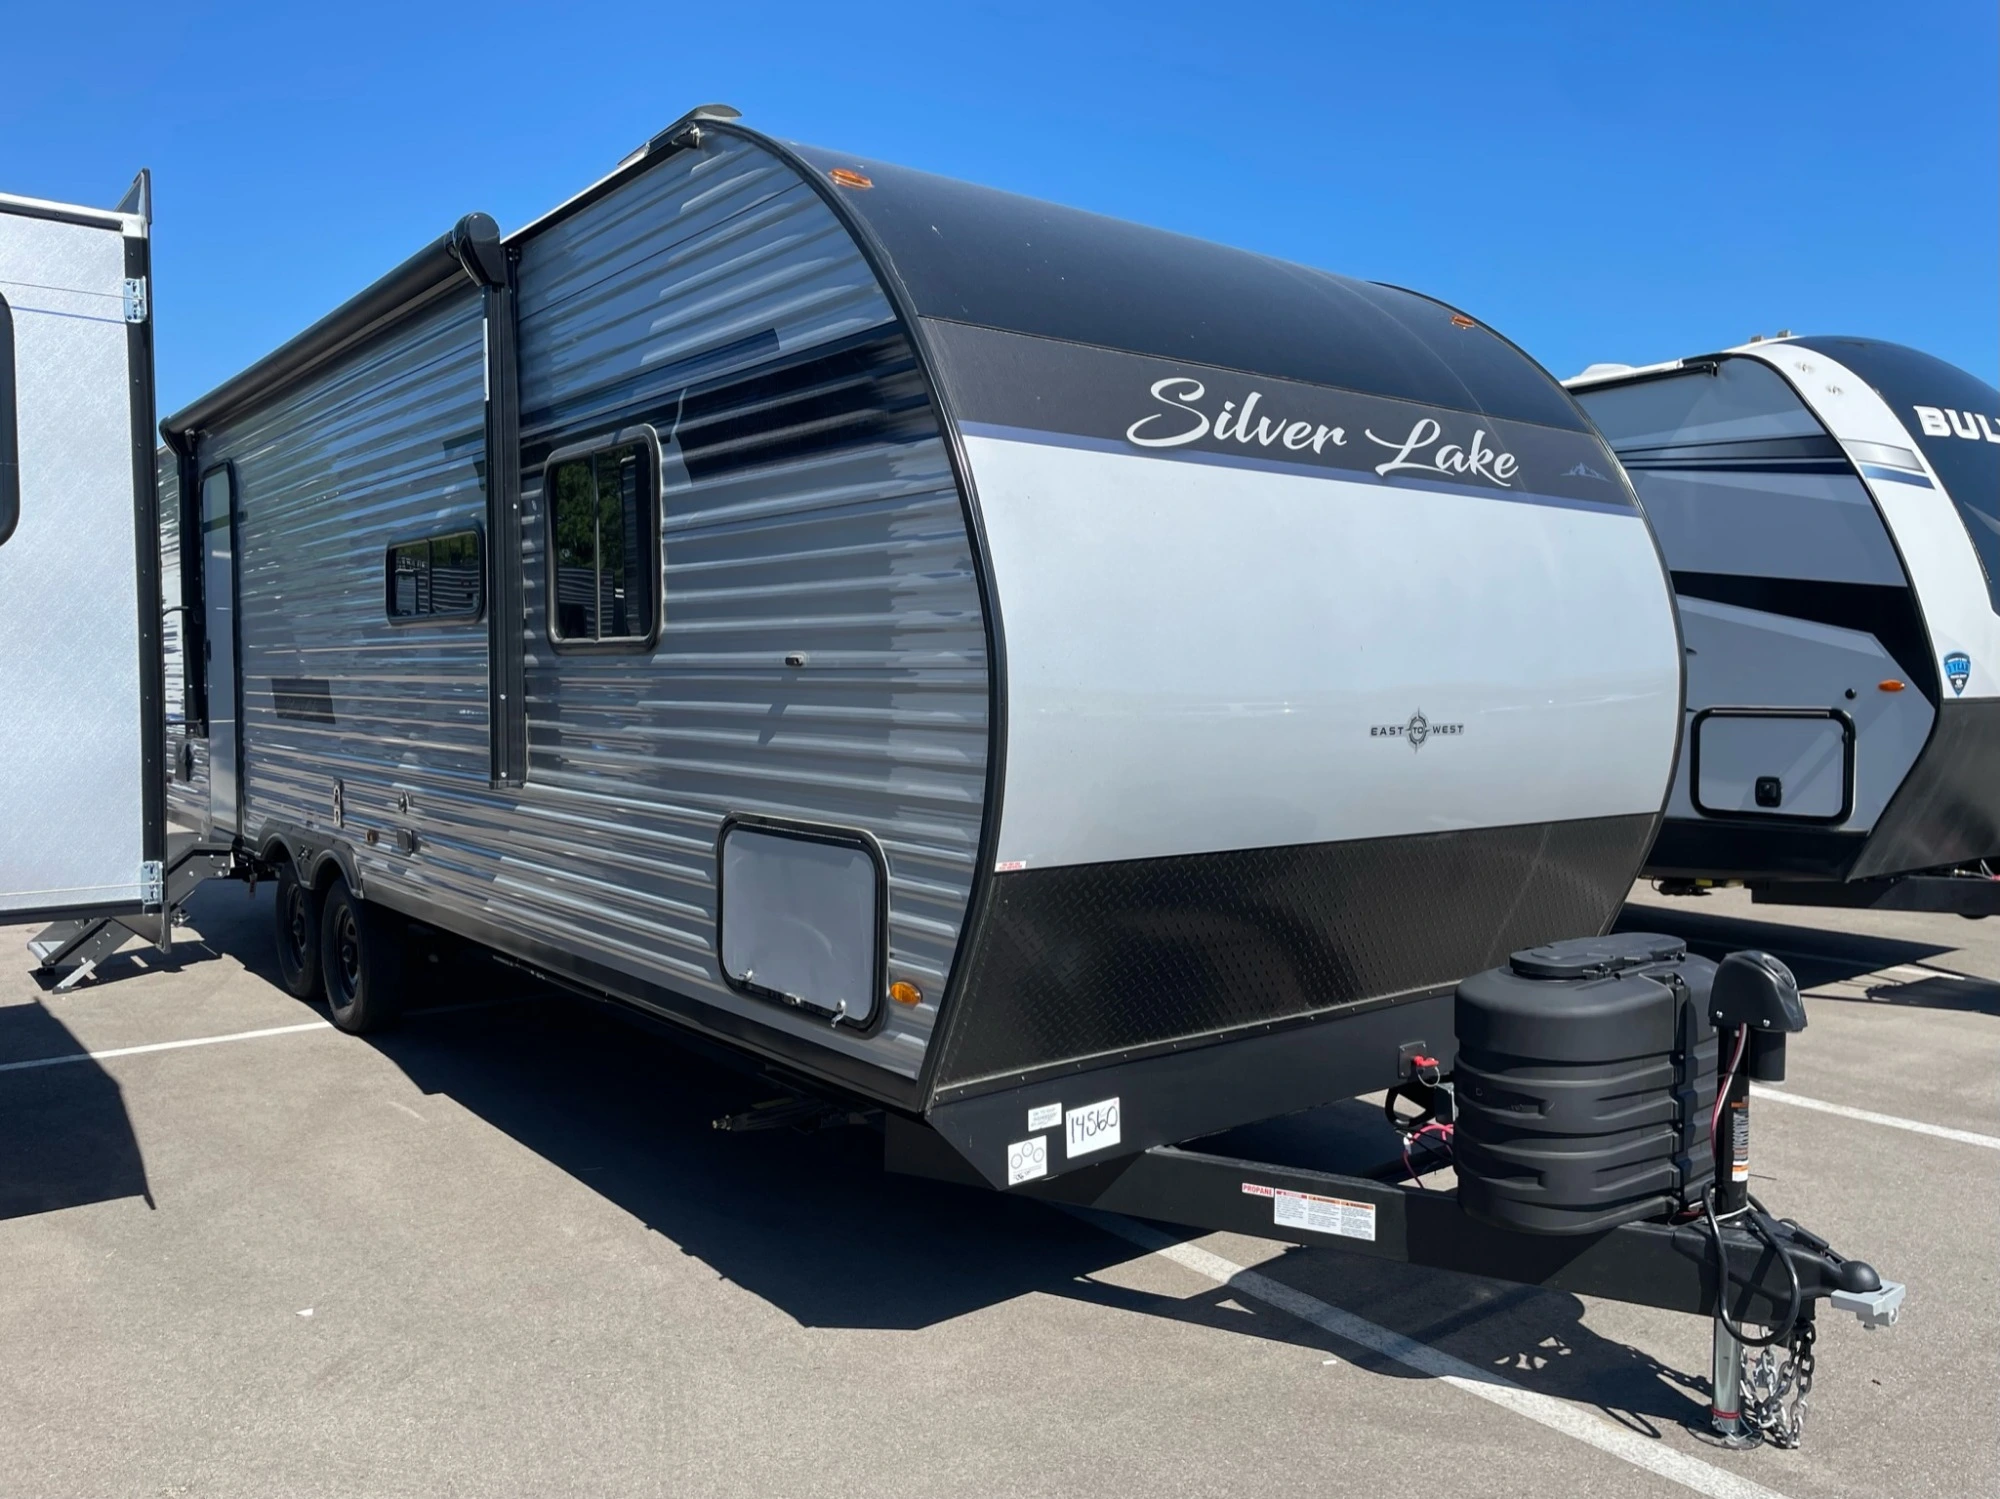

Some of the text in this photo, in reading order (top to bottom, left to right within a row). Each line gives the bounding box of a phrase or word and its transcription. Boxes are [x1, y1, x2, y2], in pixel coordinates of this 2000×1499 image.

[1126, 377, 1519, 487] Silver Lake
[1912, 405, 2000, 444] BUL
[1370, 725, 1464, 736] EAST TO WEST
[1071, 1105, 1119, 1144] 14560
[1242, 1184, 1273, 1196] PROPANE
